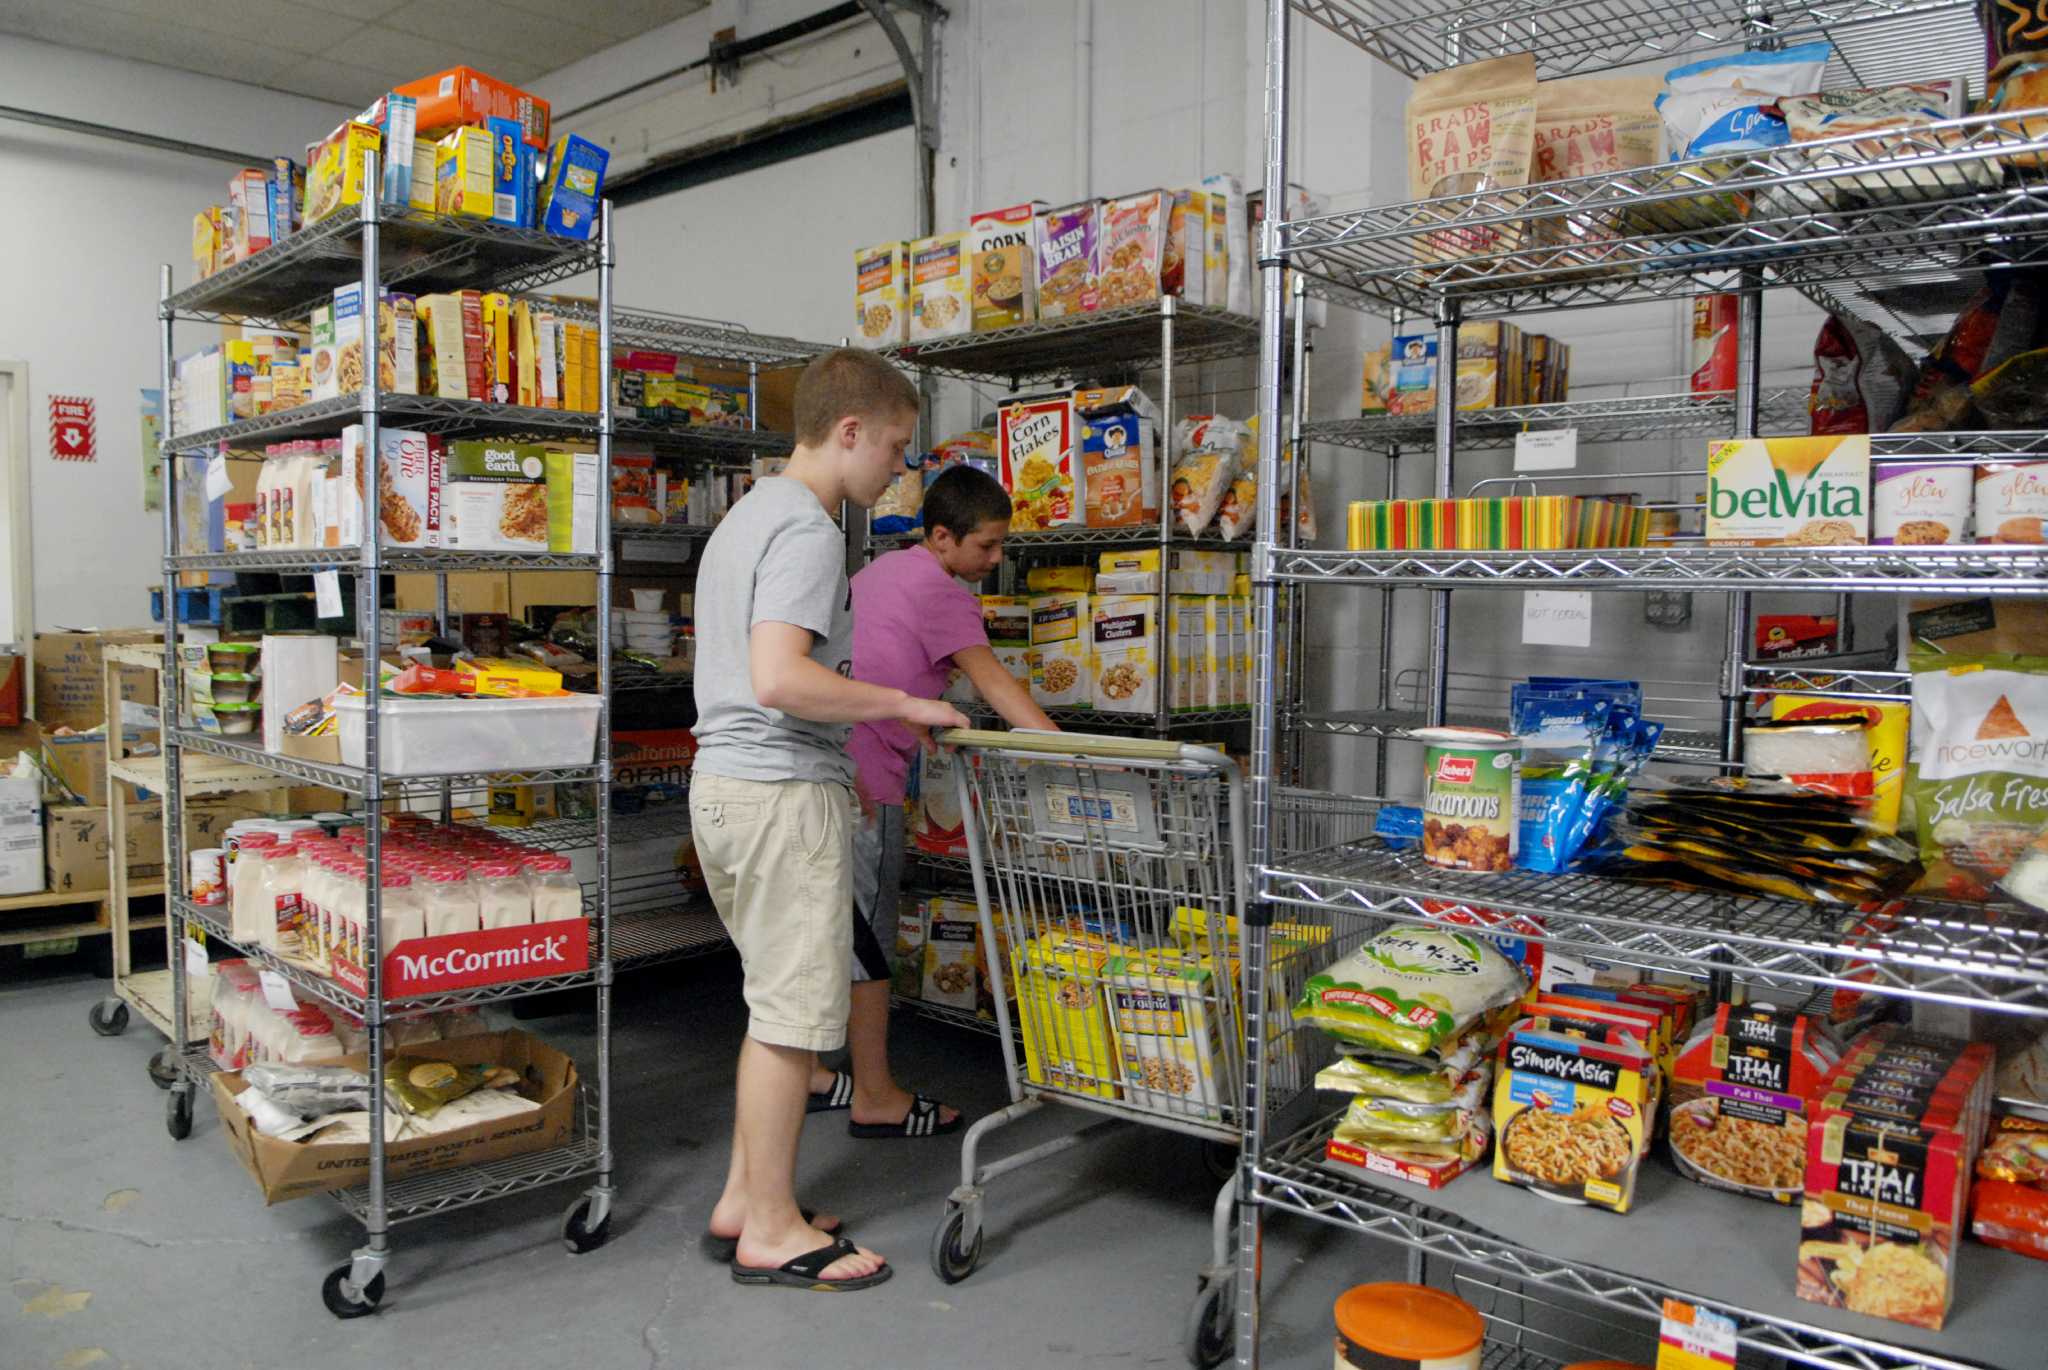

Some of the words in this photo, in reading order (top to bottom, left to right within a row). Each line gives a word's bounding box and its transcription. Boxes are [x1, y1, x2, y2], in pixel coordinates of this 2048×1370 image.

[1416, 102, 1490, 140] BRAD'S
[1535, 114, 1614, 148] BRAD'S
[1418, 119, 1490, 167] RAW
[1538, 128, 1616, 175] RAW
[1421, 147, 1494, 185] CHIPS
[981, 231, 1026, 251] CORN
[1041, 225, 1085, 252] RAISIN
[1045, 244, 1083, 268] BRAN
[1011, 413, 1051, 444] Corn
[1011, 426, 1060, 462] Flakes
[401, 439, 415, 479] One
[415, 439, 425, 476] FIBER
[429, 449, 440, 495] VALUE
[484, 448, 516, 464] good
[485, 459, 521, 473] earth
[1710, 461, 1863, 519] belVita
[1901, 476, 1947, 508] glow
[429, 496, 440, 526] PACK
[1930, 778, 1993, 823] Salsa
[399, 939, 563, 982] McCormick
[1740, 1018, 1776, 1036] THAI
[1728, 1054, 1782, 1081] THAI
[1728, 1073, 1782, 1088] KITCHEN
[1733, 1087, 1751, 1098] Pad
[1754, 1090, 1774, 1102] Thai
[1842, 1157, 1915, 1195] THAI
[1841, 1181, 1915, 1206] KITCHEN
[1845, 1199, 1868, 1213] Thai
